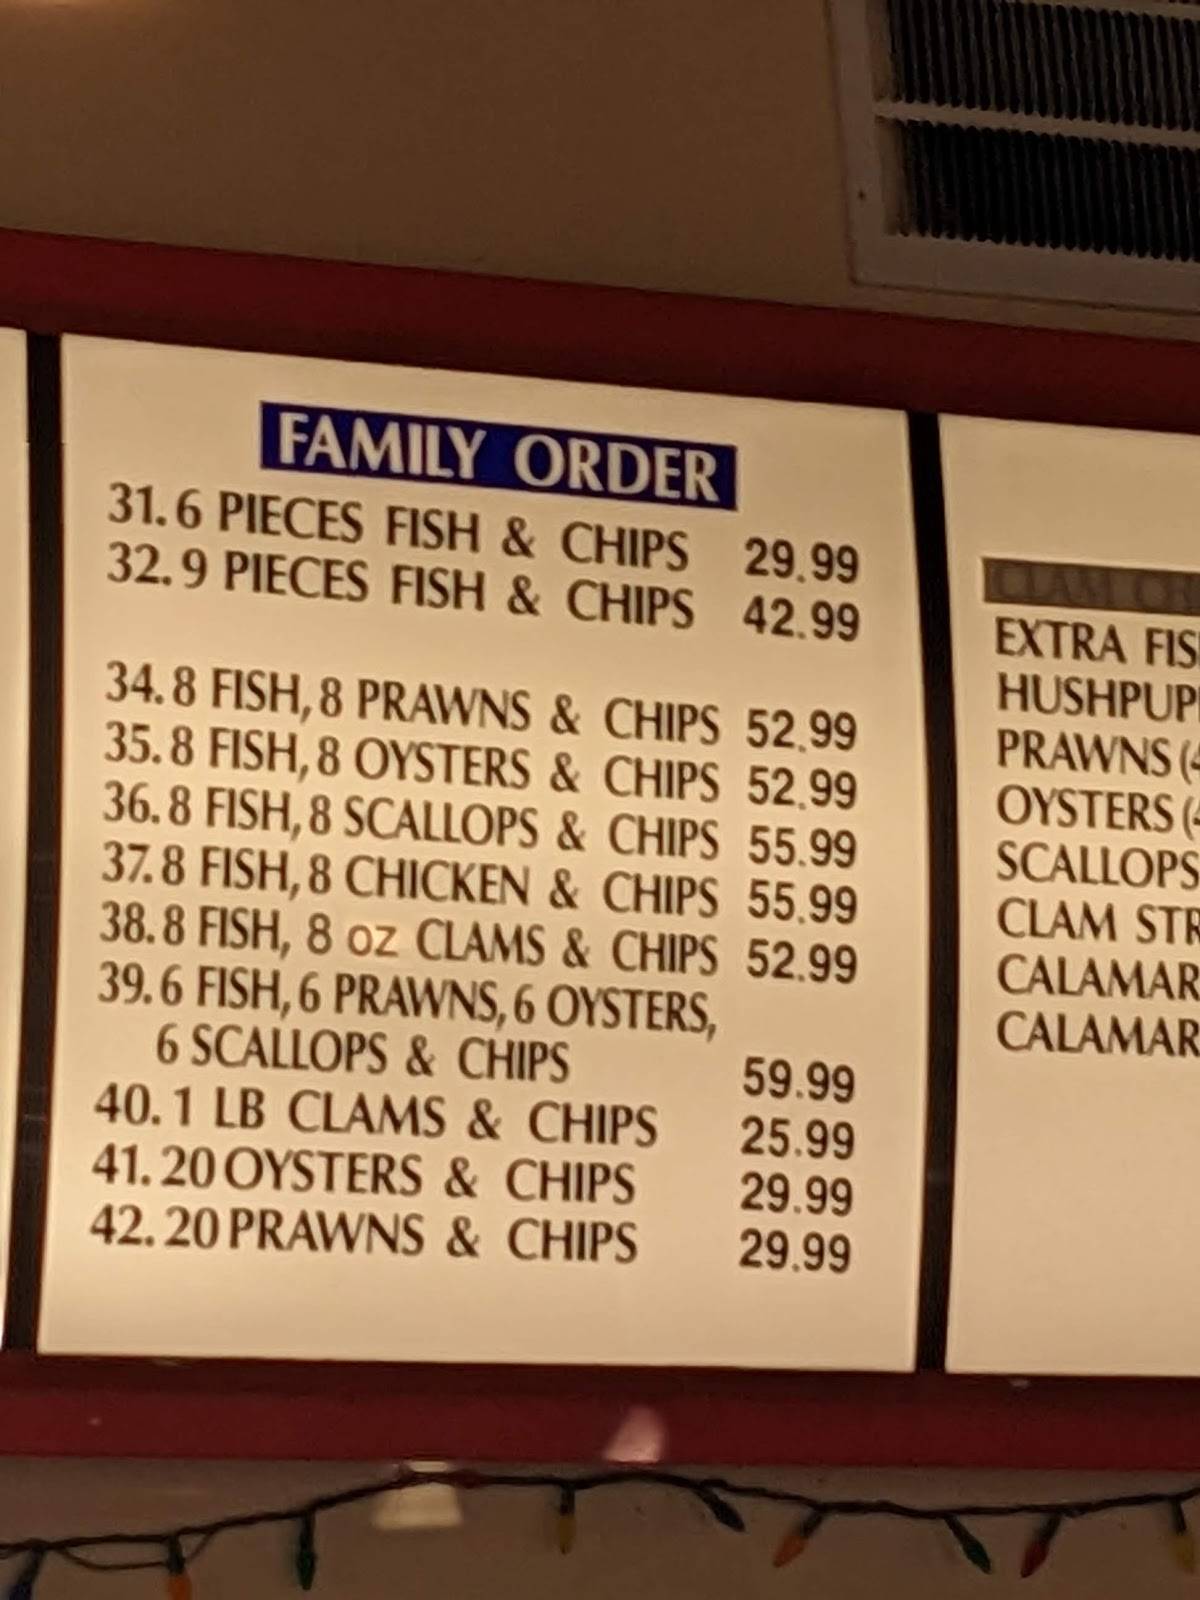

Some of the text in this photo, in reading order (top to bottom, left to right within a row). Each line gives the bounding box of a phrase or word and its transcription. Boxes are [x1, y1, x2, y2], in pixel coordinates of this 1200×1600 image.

[278, 411, 719, 502] FAMILY ORDER
[108, 481, 860, 585] 31. 6 PIECES FISH & CHIPS 29.99
[106, 540, 861, 643] 32. 9 PIECES FISH & CHIPS 42.99
[994, 615, 1200, 670] EXTRA FIS
[105, 660, 858, 754] 34. 8 FISH, 8 PRAWNS & CHIPS 52.99
[997, 671, 1200, 724] HUSHPUP
[104, 720, 858, 811] 35. 8 FISH, 8 OYSTERS & CHIPS 52.99
[997, 728, 1172, 778] PRAWNS
[103, 779, 858, 870] 36. 8 FISH, 8 SCALLOPS & CHIPS 55.99
[996, 783, 1175, 834] OYSTERS
[101, 840, 858, 926] 37. 8 FISH, 8 CHICKEN & CHIPS 55.99
[996, 839, 1200, 892] SCALLOPS
[99, 900, 156, 945] 38.
[162, 903, 186, 947] 8
[198, 904, 291, 961] FISH,
[306, 912, 333, 956] 8
[415, 917, 546, 967] CLAMS
[561, 927, 590, 970] &
[611, 929, 719, 977] CHIPS
[746, 937, 858, 985] 52.99
[996, 896, 1118, 943] CLAM
[97, 960, 717, 1042] 39. 6 FISH, 6 PRAWNS, 6 OYSTERS,
[997, 952, 1200, 1003] CALAMAR
[156, 1022, 856, 1105] 6 SCALLOPS & CHIPS 59.99
[996, 1009, 1200, 1059] CALAMAR
[93, 1082, 856, 1161] 40. 1 LB CLAMS & CHIPS 25.99
[91, 1142, 854, 1218] 41. 20 OYSTERS & CHIPS 29.99
[89, 1203, 852, 1275] 42. 20 PRAWNS & CHIPS 29.99
